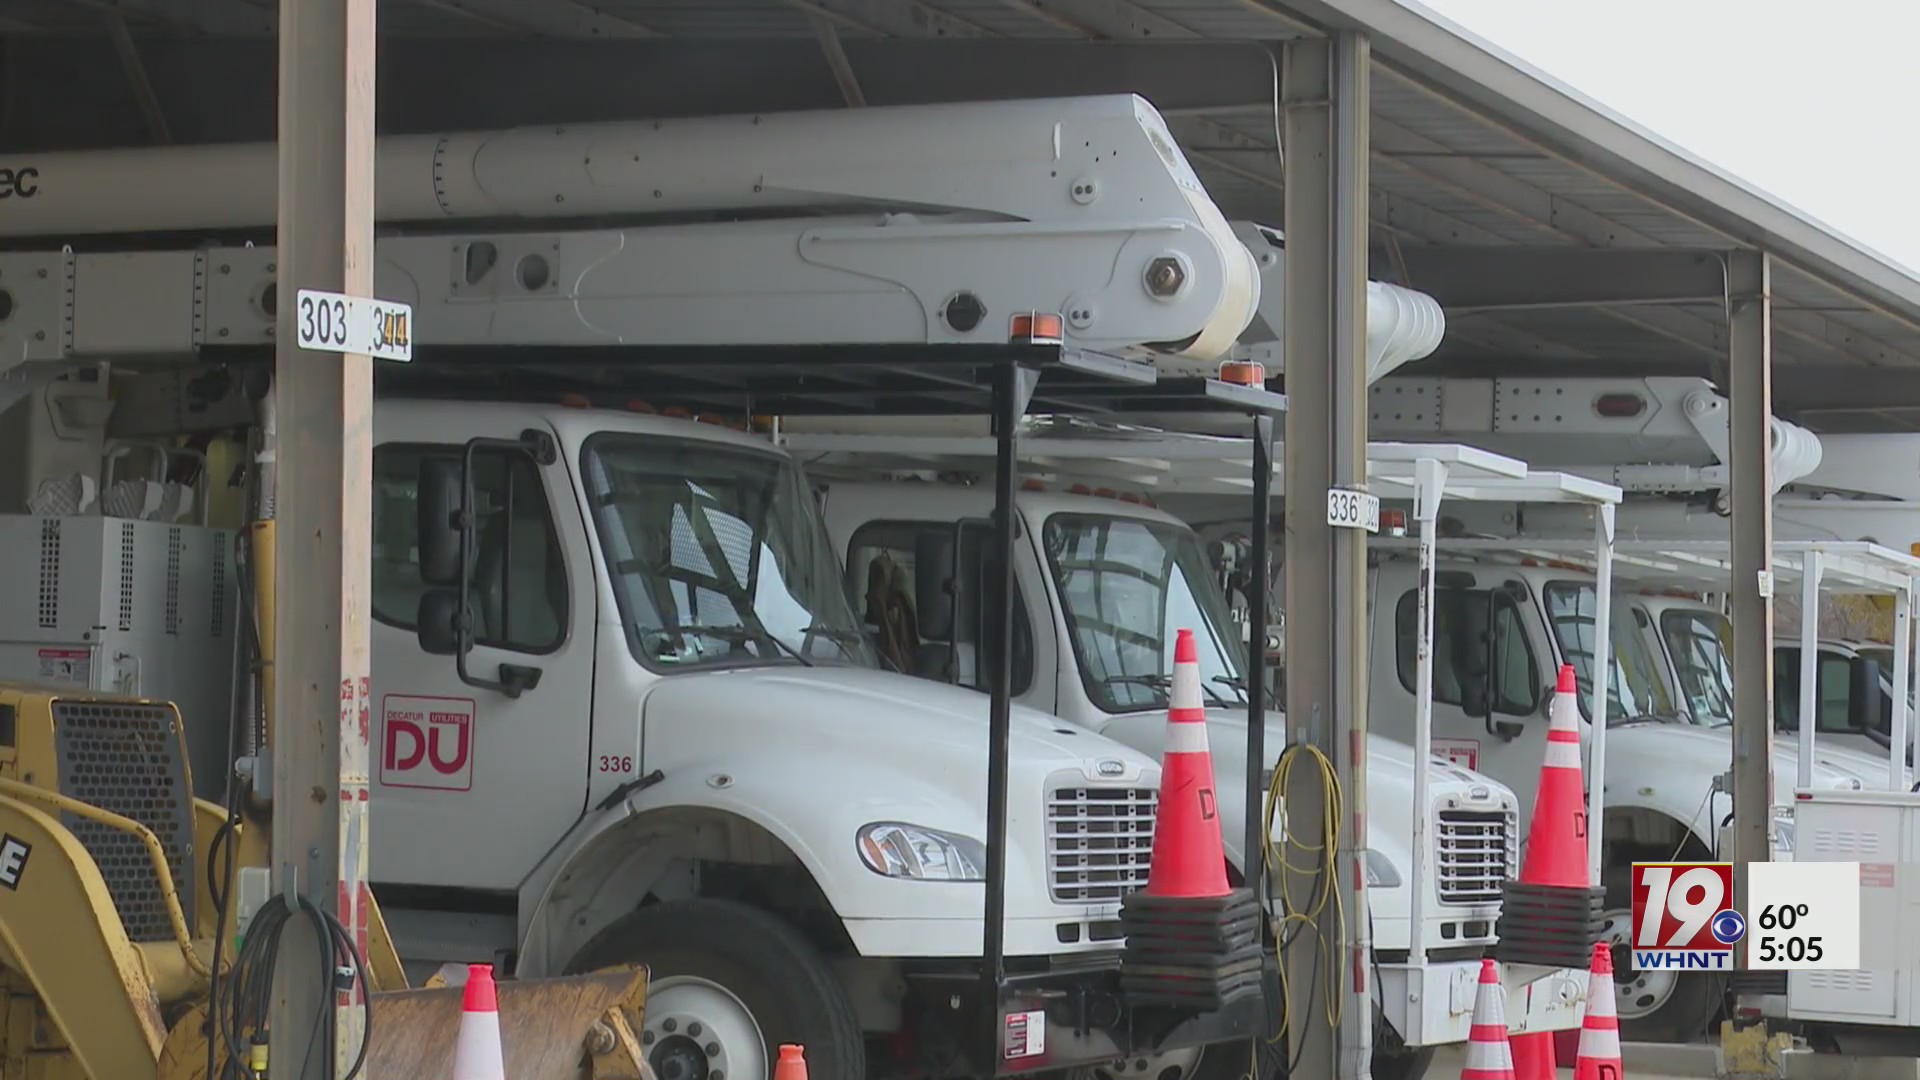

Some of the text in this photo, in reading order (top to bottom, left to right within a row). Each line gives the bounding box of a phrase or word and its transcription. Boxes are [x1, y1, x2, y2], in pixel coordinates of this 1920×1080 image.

[301, 297, 408, 353] 303 344
[1330, 493, 1358, 522] 336
[387, 711, 424, 721] DECATUR
[386, 720, 469, 774] DU
[600, 755, 632, 772] 336
[1198, 788, 1215, 820] D
